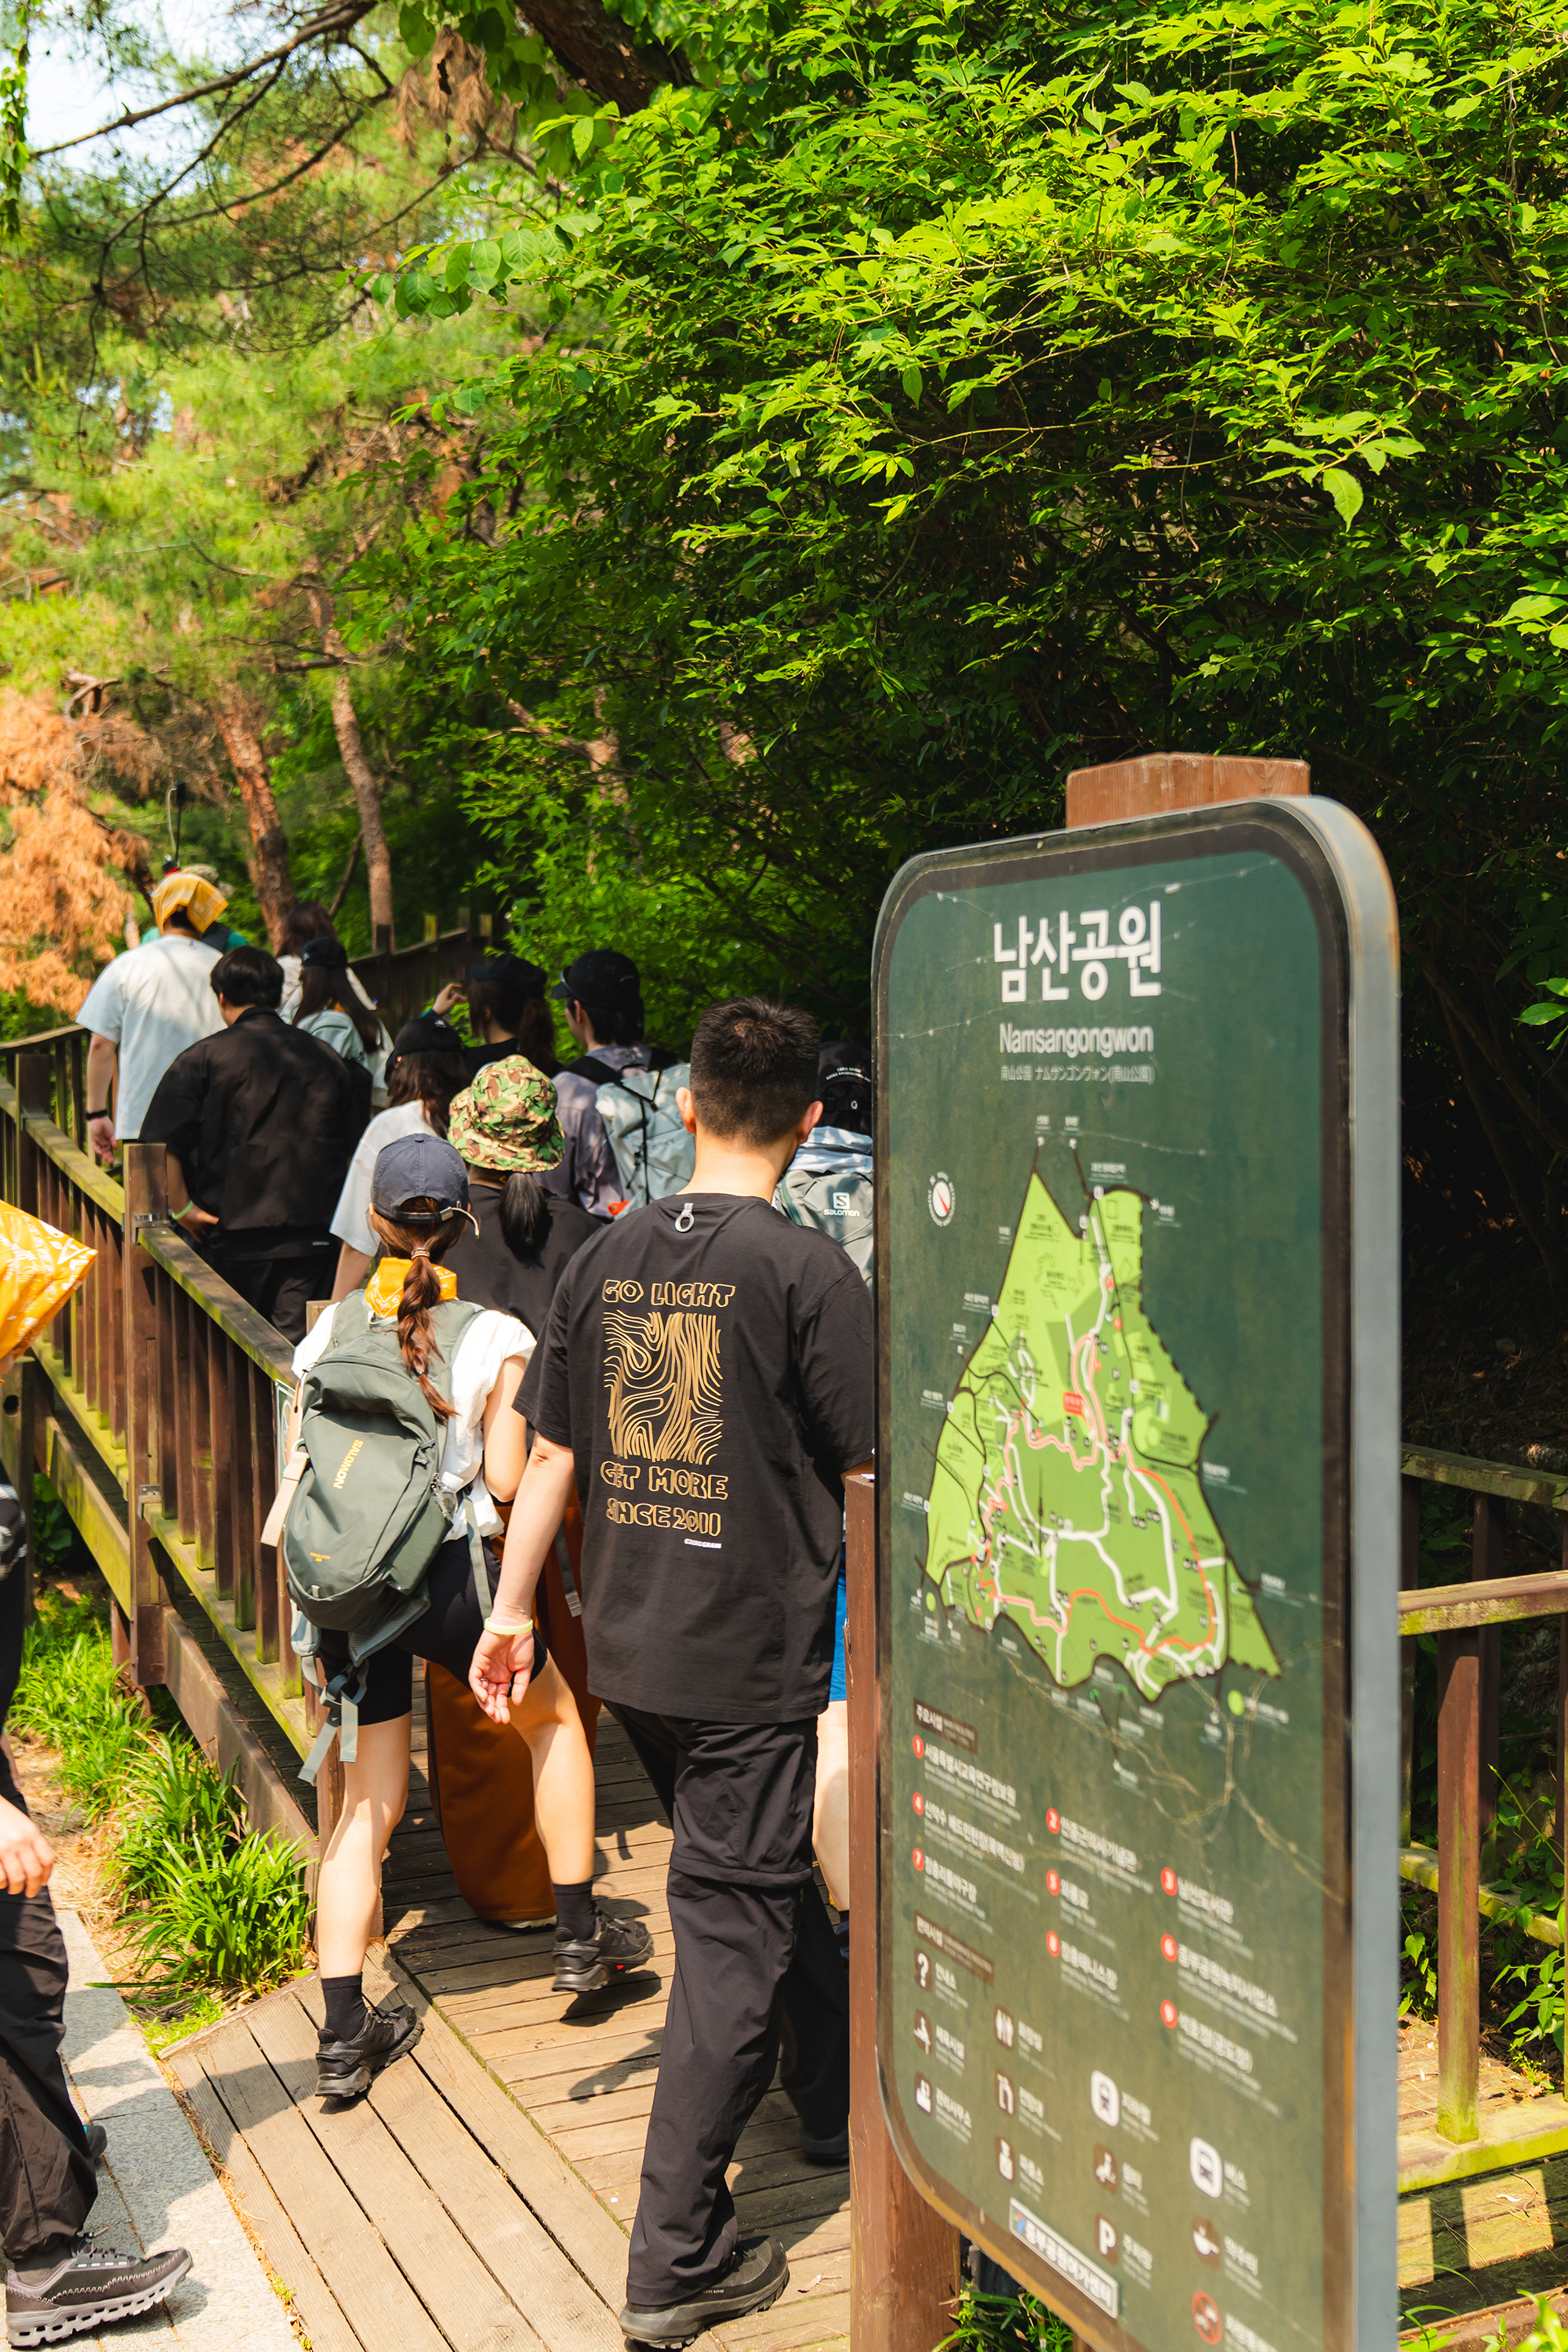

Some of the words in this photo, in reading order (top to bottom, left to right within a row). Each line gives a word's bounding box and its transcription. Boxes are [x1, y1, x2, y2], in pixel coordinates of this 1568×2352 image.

[993, 901, 1162, 1003] 남산공원
[1000, 1023, 1154, 1058] Namsangongwon
[602, 1279, 644, 1304] GO
[651, 1281, 735, 1308] LIGHT
[332, 1439, 364, 1490] SALOMON
[648, 1466, 729, 1501] MORE
[916, 1704, 943, 1732] 주요시설
[1060, 1816, 1137, 1873] 안중근의사기념관
